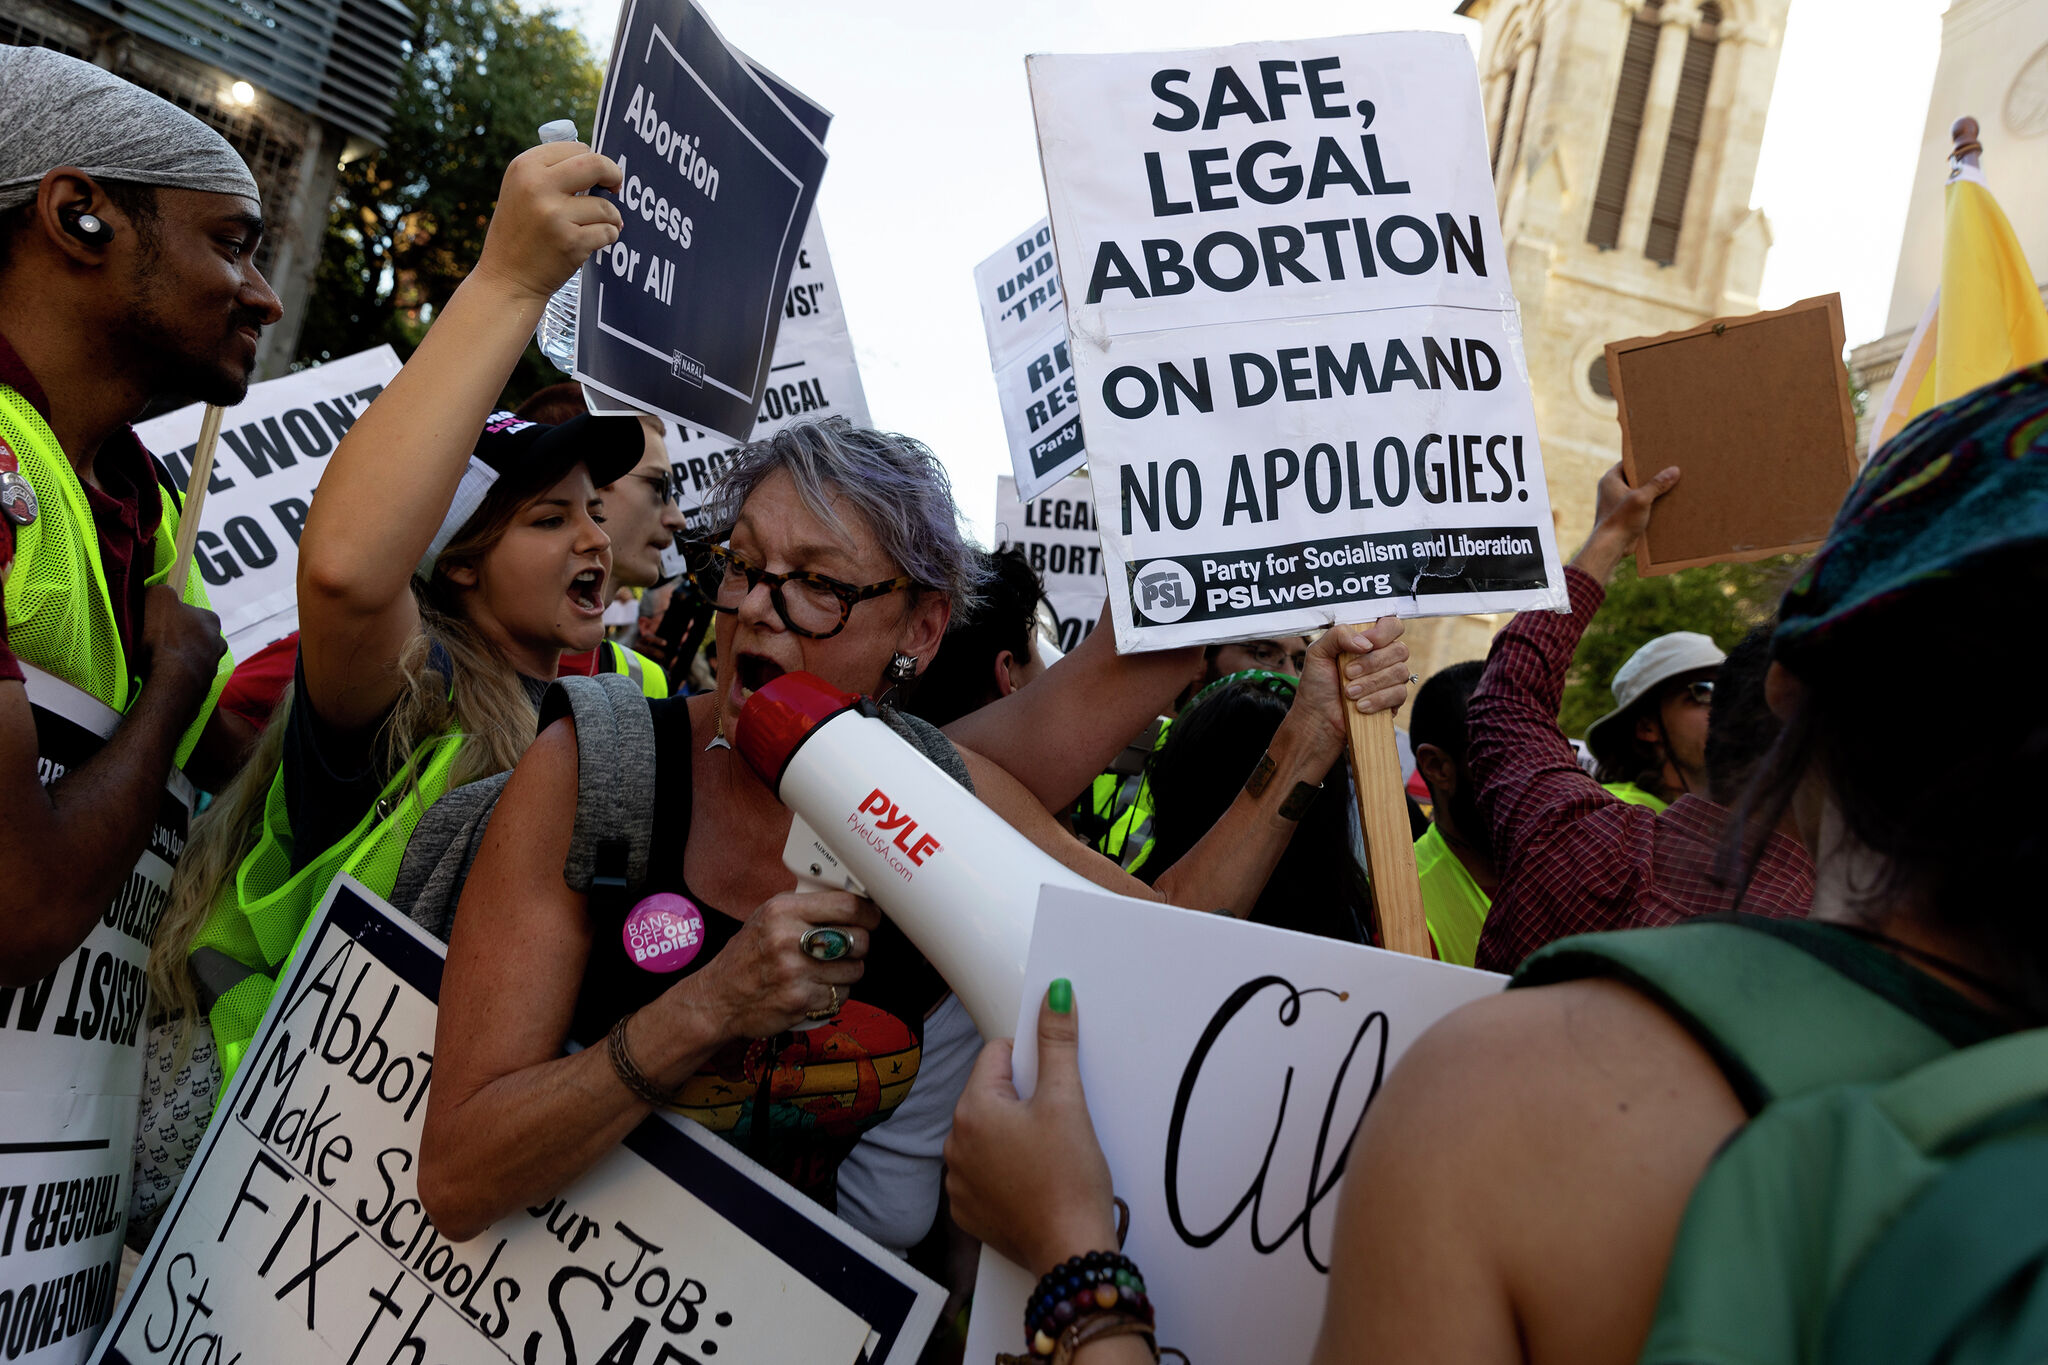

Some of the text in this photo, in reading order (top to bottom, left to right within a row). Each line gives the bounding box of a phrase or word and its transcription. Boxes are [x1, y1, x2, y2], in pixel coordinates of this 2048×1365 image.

[1151, 56, 1376, 132] SAFE,
[623, 83, 720, 202] Abortion
[1144, 134, 1411, 218] LEGAL
[643, 254, 677, 307] All
[1085, 212, 1488, 305] ABORTION
[681, 359, 702, 379] NARAL
[1101, 336, 1501, 420] ON DEMAND
[1036, 423, 1077, 459] Party
[1120, 433, 1529, 536] NO APOLOGIES!
[194, 515, 279, 587] GO
[1202, 533, 1534, 583] Party for Socialism and Liberation
[1141, 581, 1191, 611] PSL
[1206, 572, 1393, 613] PSLweb.org
[847, 812, 914, 883] PyleUSA.com
[628, 912, 671, 937] BANS
[631, 917, 702, 949] OFF OUR
[634, 931, 699, 962] BODIES
[54, 946, 148, 1048] RESIST
[241, 1030, 353, 1188] Make
[217, 1150, 359, 1330] FIX
[604, 1220, 733, 1355] JOB:
